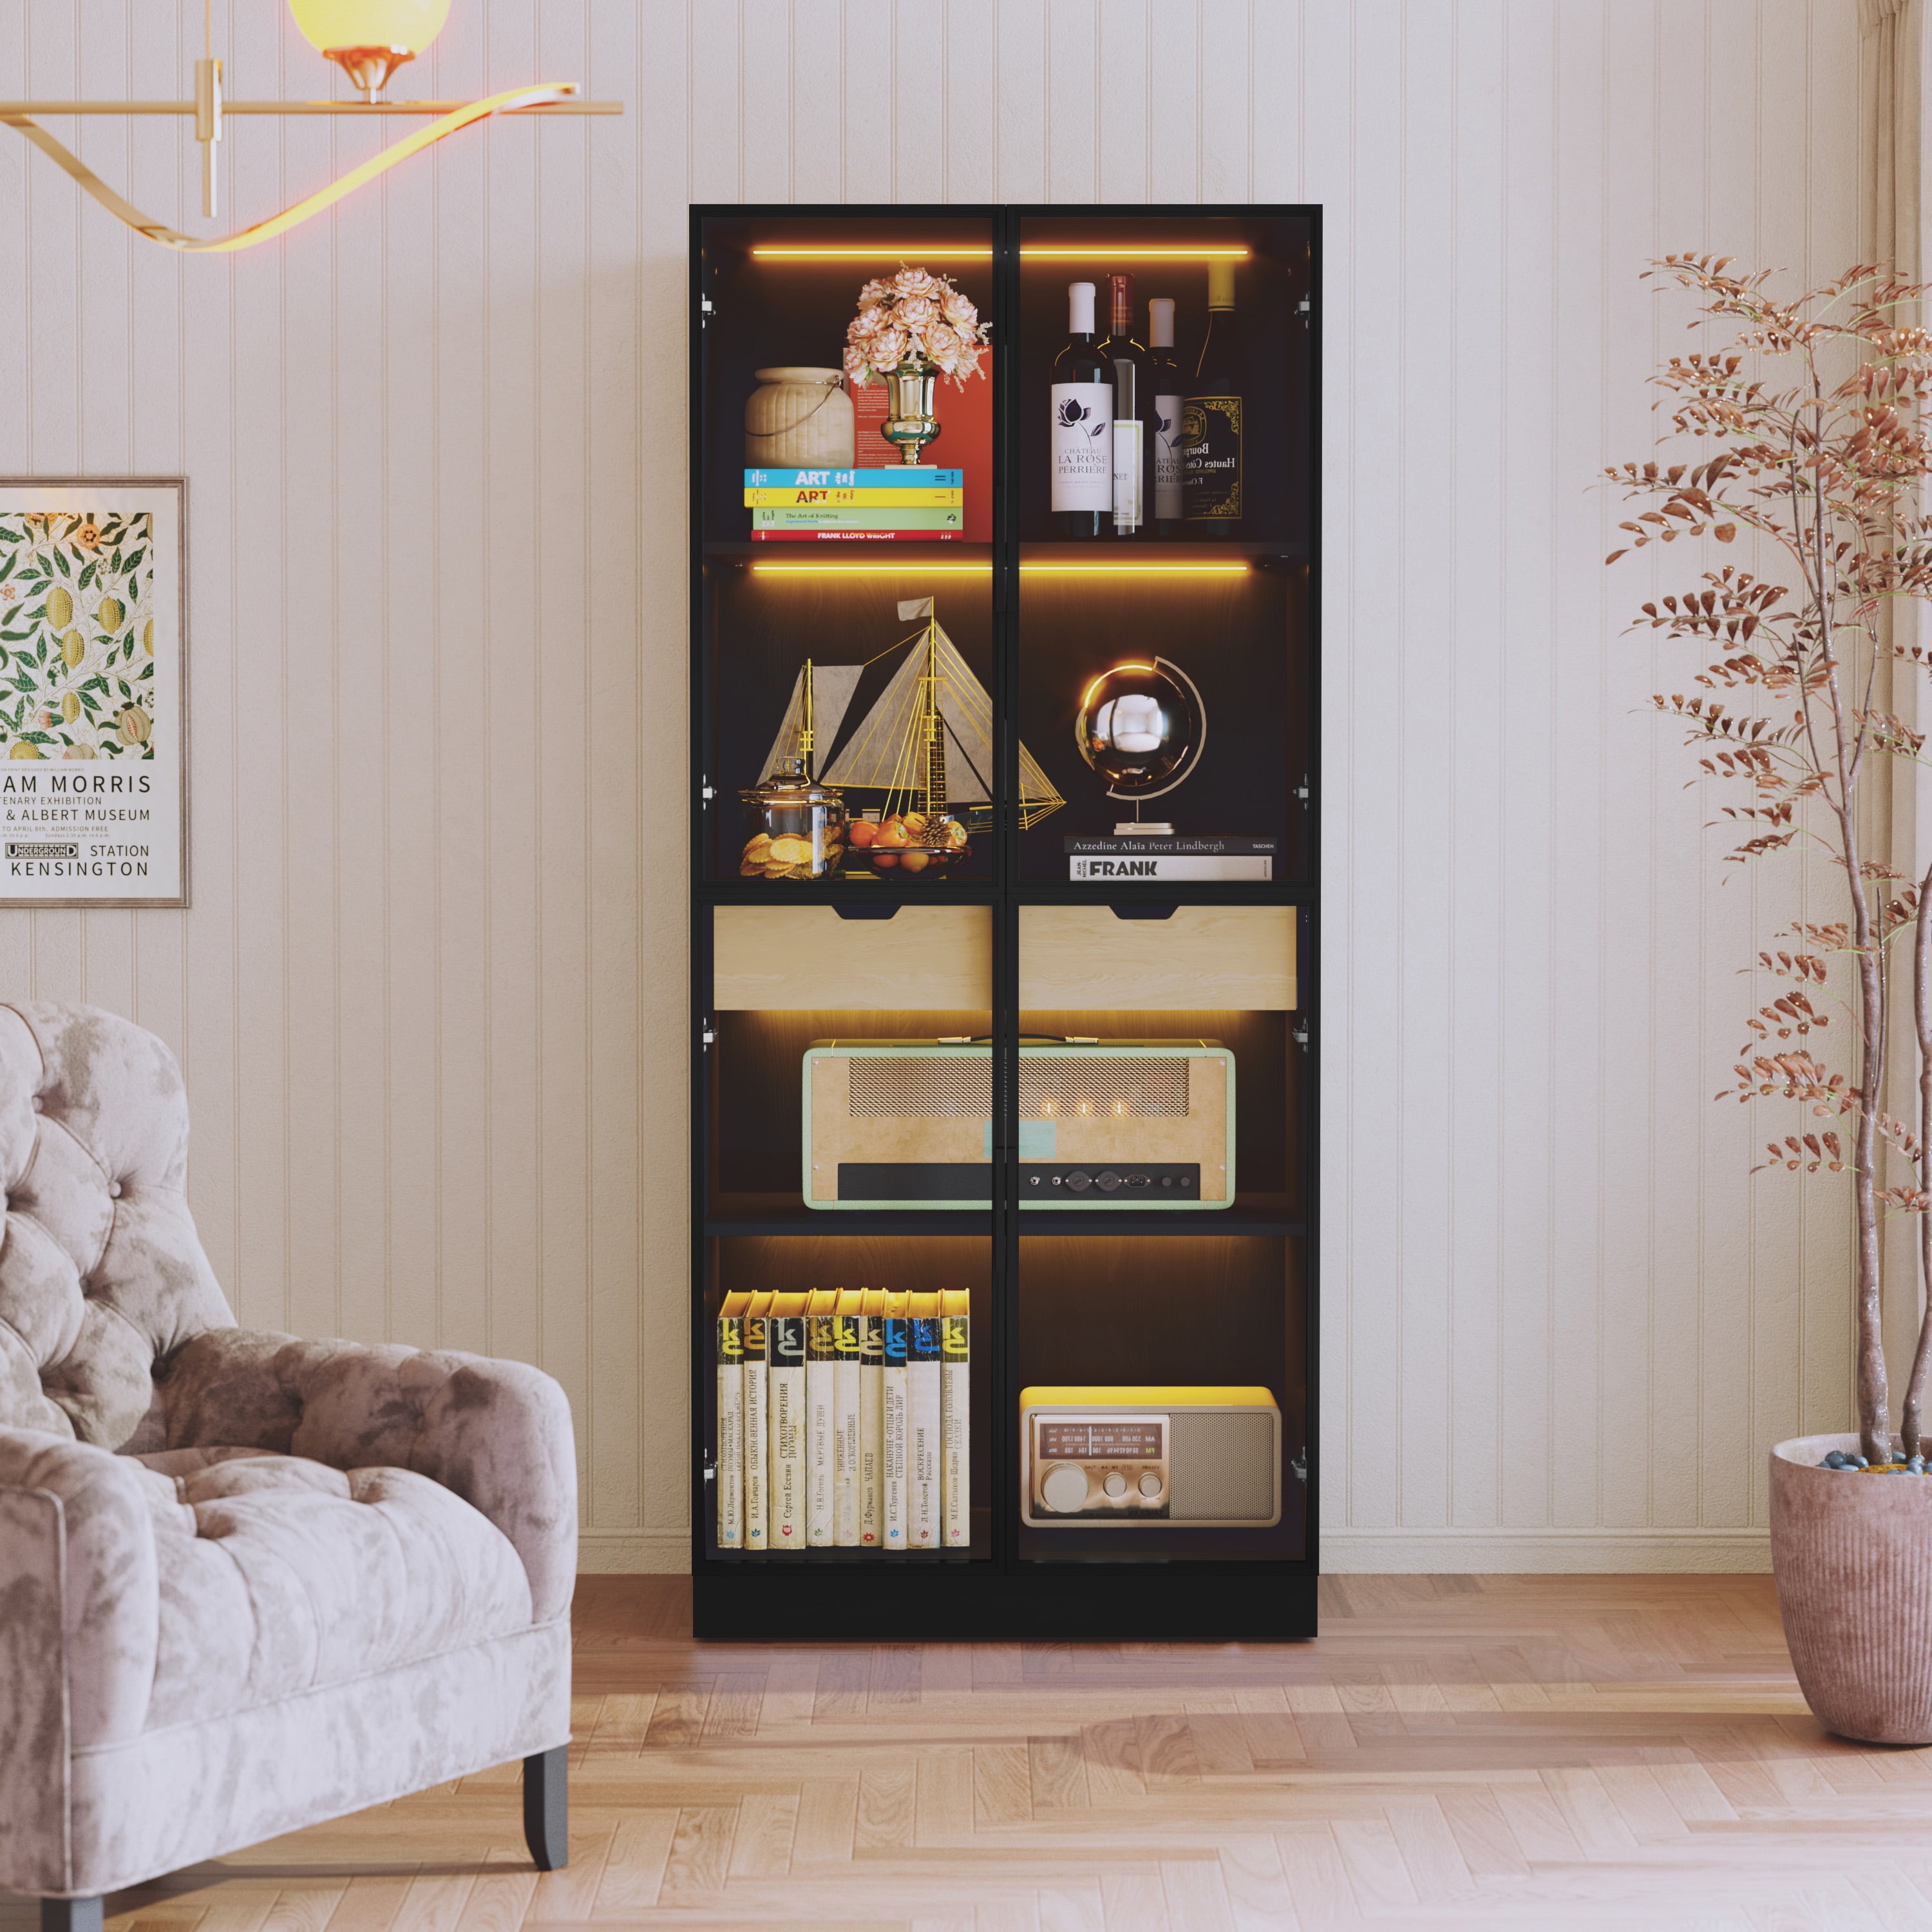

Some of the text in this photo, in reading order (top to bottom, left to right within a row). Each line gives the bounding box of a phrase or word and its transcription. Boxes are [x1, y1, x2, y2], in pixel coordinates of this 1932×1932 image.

[1059, 455, 1108, 464] LA ROSE
[1059, 464, 1107, 473] PERRIÈRE
[795, 471, 830, 485] ART
[796, 491, 828, 503] ART
[3, 776, 150, 793] AM MORRIS
[6, 810, 149, 820] & ALBERT MUSEUM
[7, 844, 77, 857] UNDERGROUND
[90, 846, 149, 857] STATION
[1074, 842, 1117, 850] Azzedine
[1121, 842, 1145, 850] Alaïa
[1176, 841, 1224, 853] Lindbergh
[12, 862, 147, 876] KENSINGTON
[1090, 861, 1157, 876] FRANK
[779, 1383, 788, 1459] СТИХОТВОРЕНИЯ
[895, 1395, 904, 1479] СТЕПНОЙ КОРОЛЬ ЛИР
[864, 1453, 873, 1482] ЧАПАЕВ
[783, 1493, 791, 1519] Сергей
